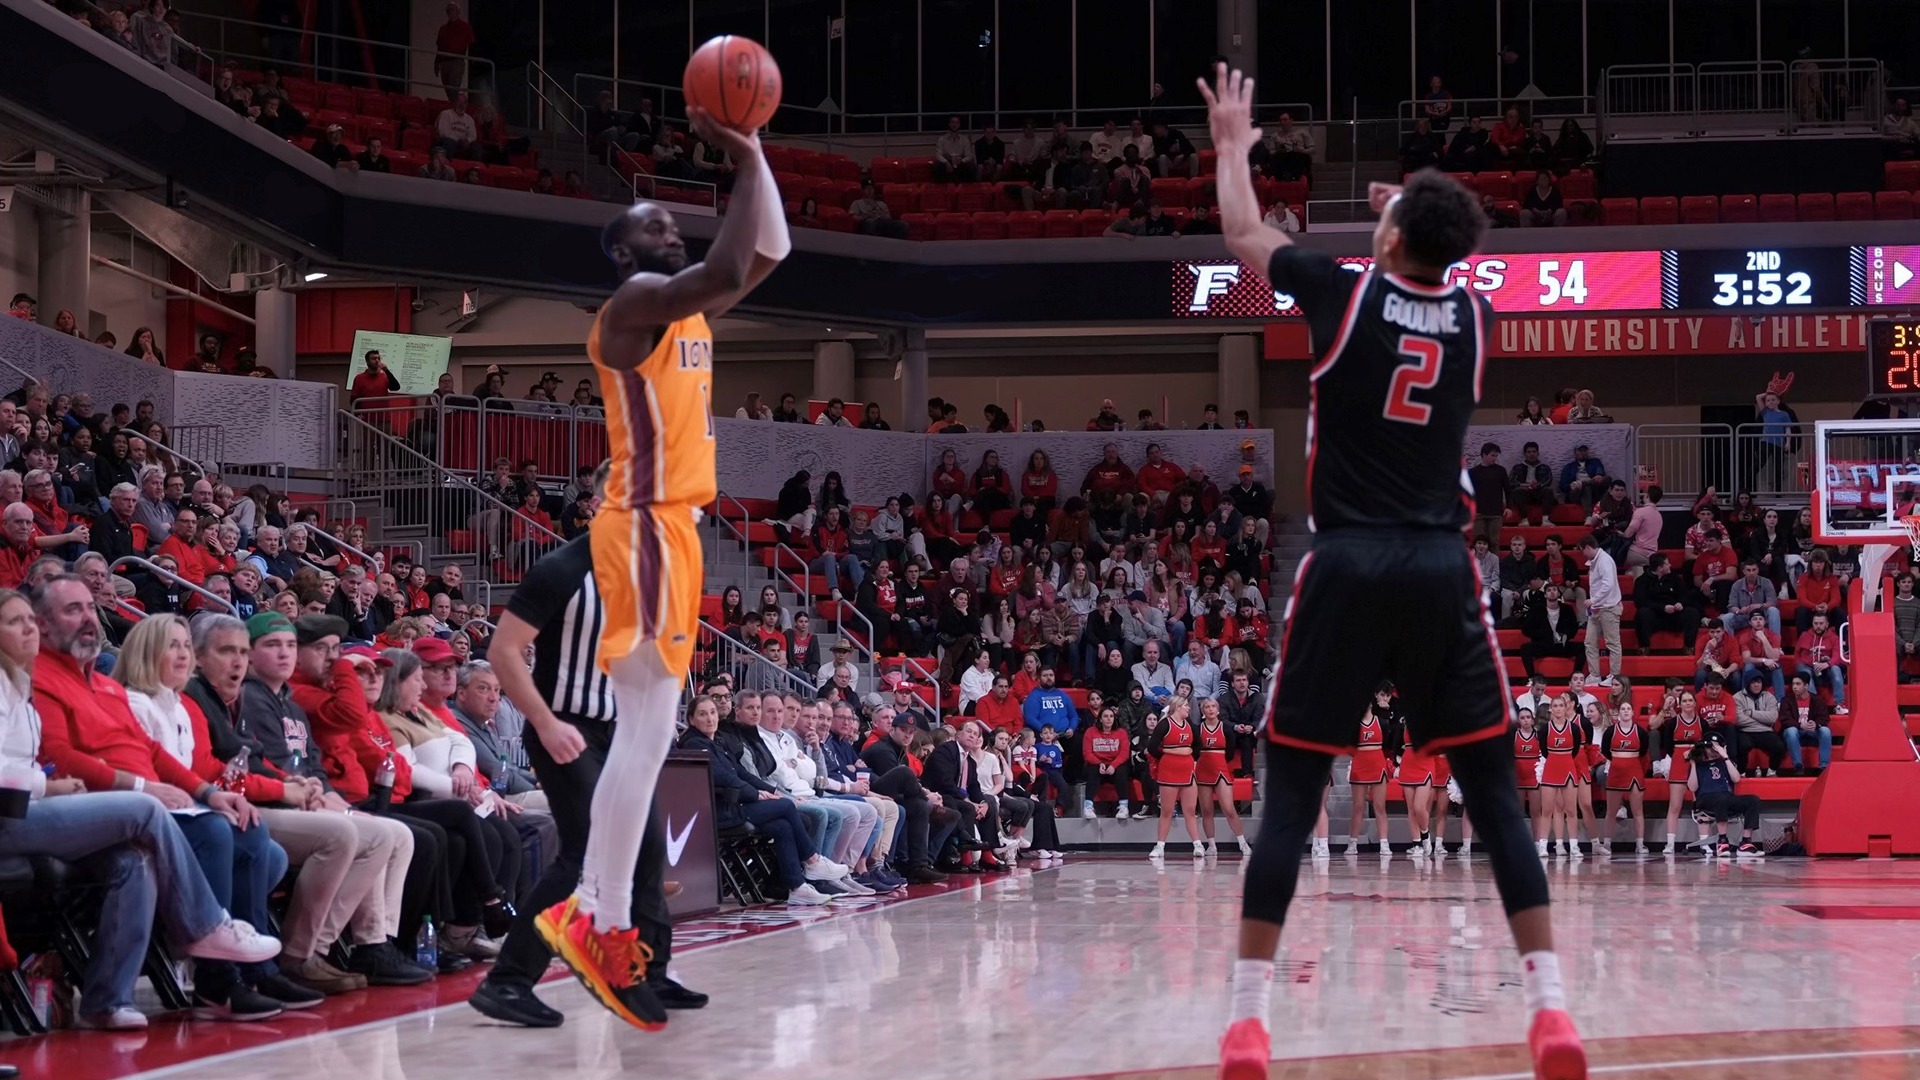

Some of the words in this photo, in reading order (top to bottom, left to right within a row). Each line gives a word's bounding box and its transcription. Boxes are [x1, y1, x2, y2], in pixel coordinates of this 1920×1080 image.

[1746, 251, 1781, 270] 2ND
[1873, 246, 1884, 303] BONUS
[1538, 259, 1588, 306] 54
[1712, 271, 1812, 306] 3:52
[1501, 317, 1703, 352] UNIVERSITY
[1728, 313, 1911, 349] ATHLETI
[1382, 334, 1444, 426] 2
[1042, 699, 1064, 709] COLTS
